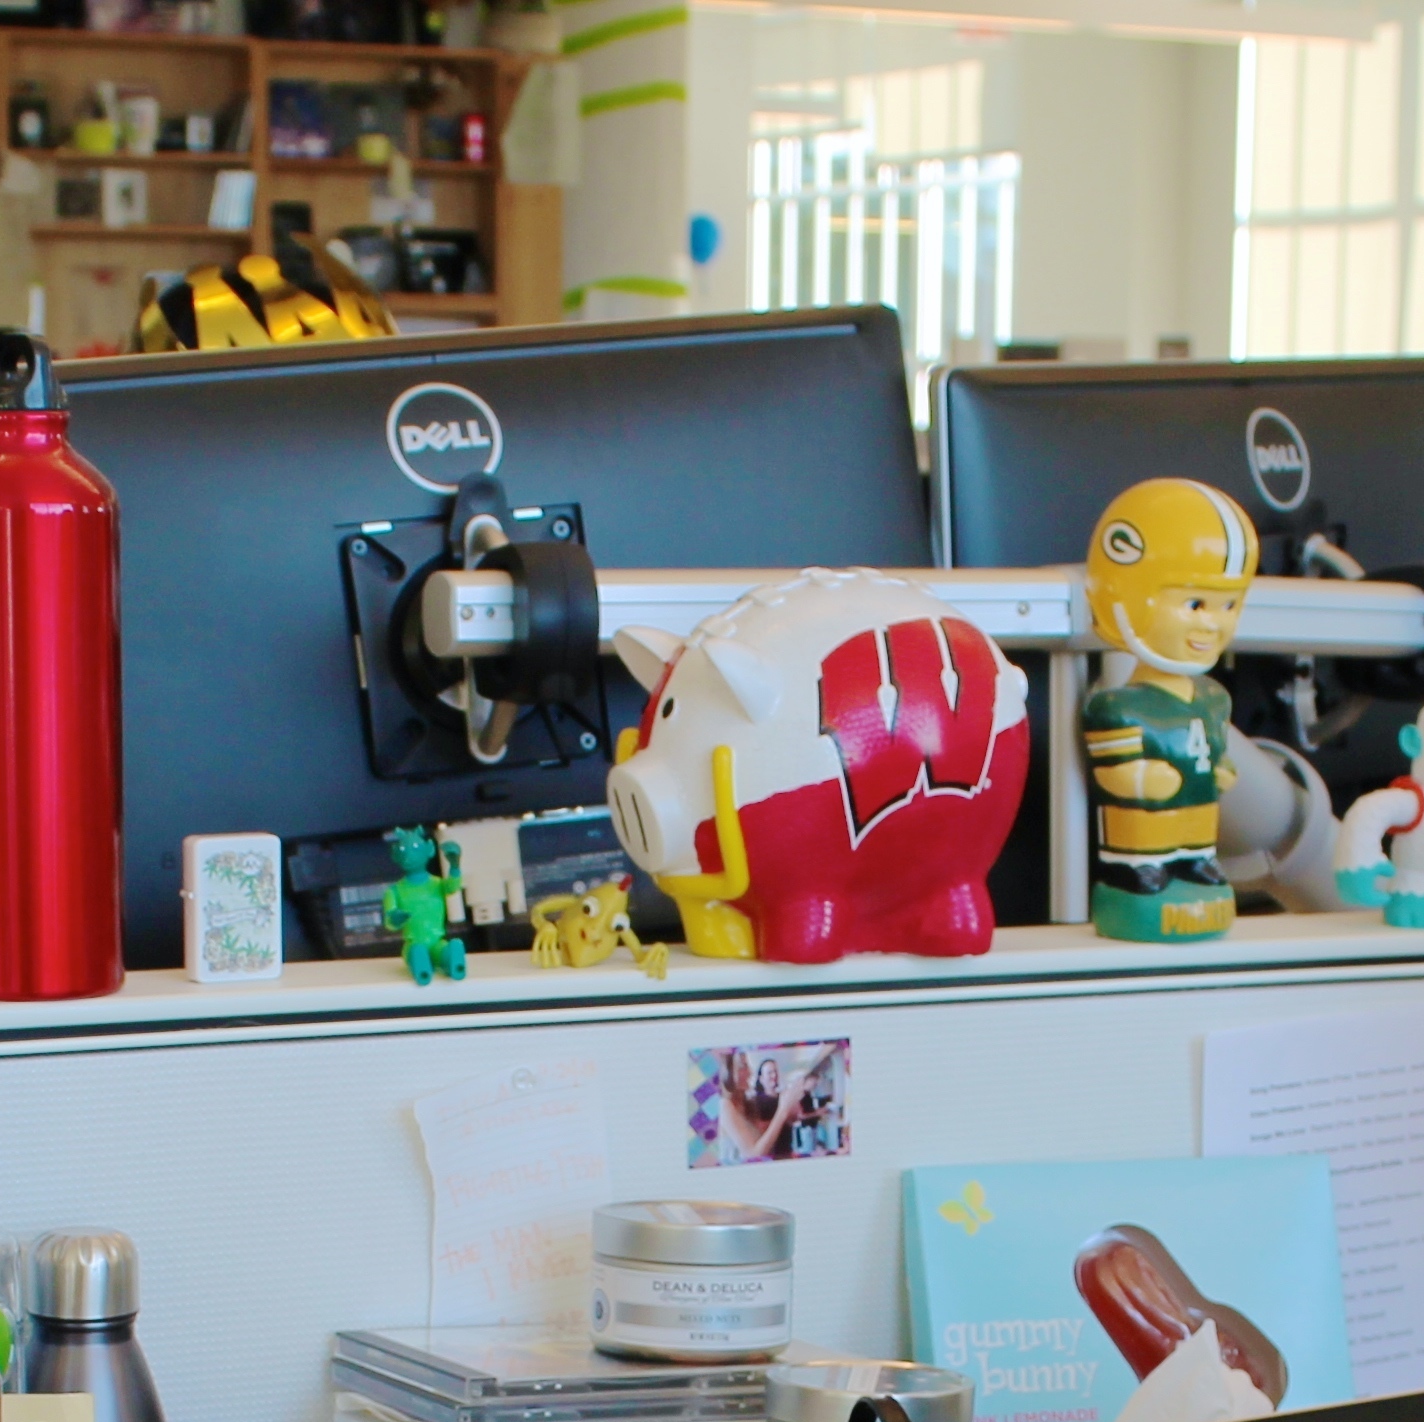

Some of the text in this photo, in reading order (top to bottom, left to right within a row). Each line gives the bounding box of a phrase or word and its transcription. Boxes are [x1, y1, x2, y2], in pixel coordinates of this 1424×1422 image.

[400, 420, 492, 452] DELL
[1253, 441, 1304, 474] DELL
[1186, 717, 1212, 774] 4
[652, 1280, 764, 1293] DEAN & DELUCA
[943, 1317, 1085, 1367] gummy
[976, 1350, 1099, 1399] bunny
